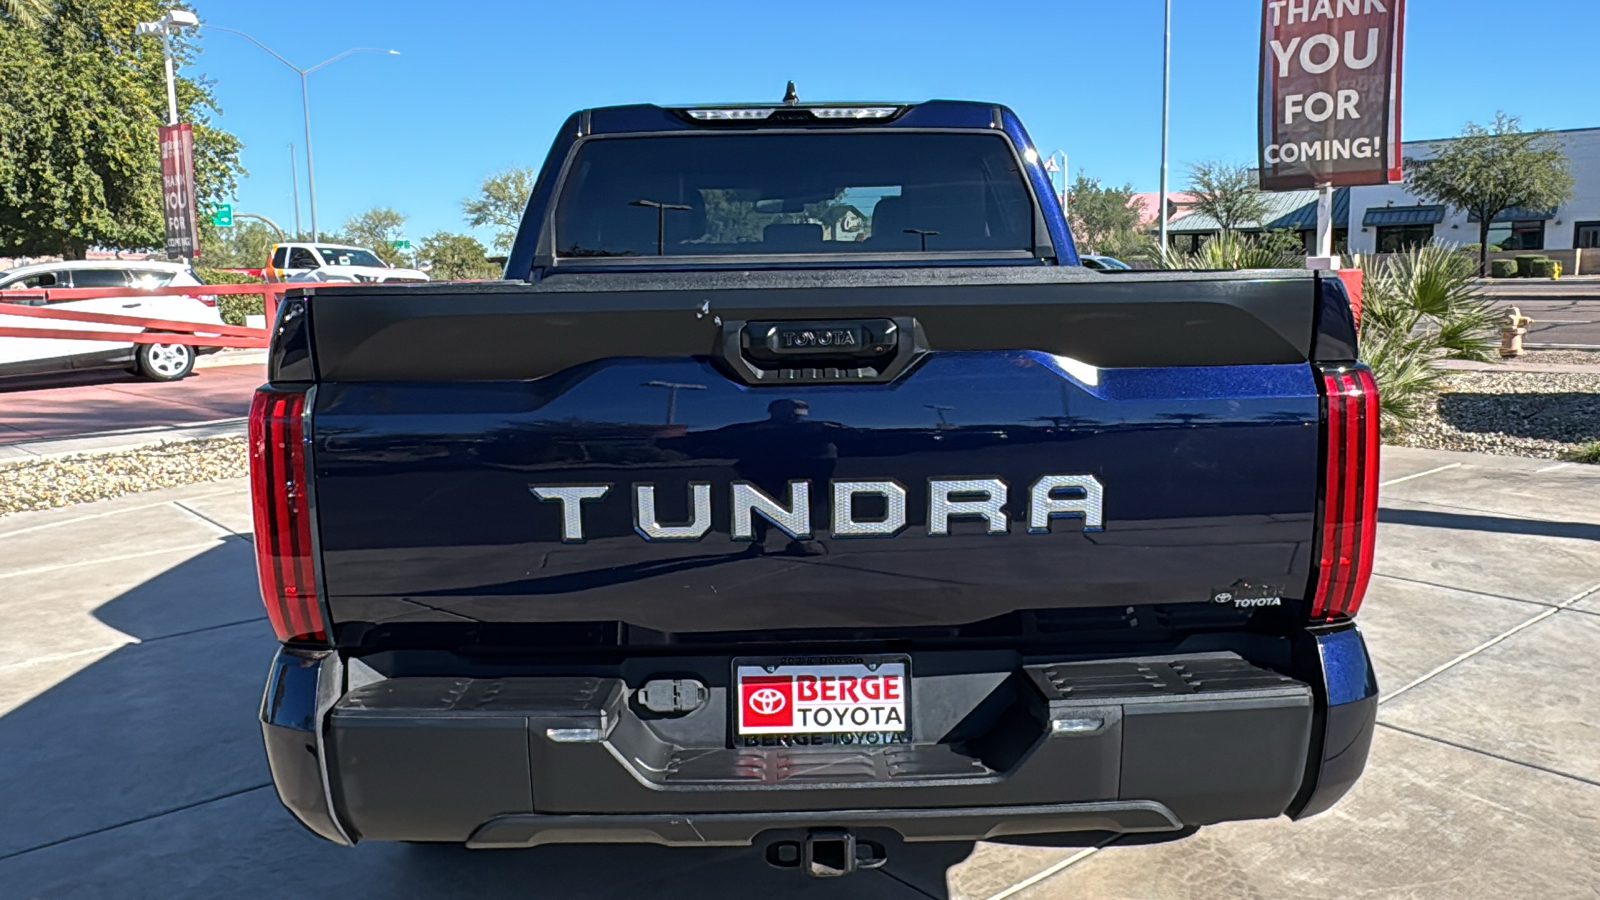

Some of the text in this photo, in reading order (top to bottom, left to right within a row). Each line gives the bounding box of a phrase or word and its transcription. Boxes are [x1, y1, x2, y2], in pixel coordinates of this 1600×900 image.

[1269, 0, 1387, 26] THANK
[1269, 28, 1379, 78] YOU
[1284, 89, 1361, 125] FOR
[1264, 136, 1380, 164] COMING!
[165, 191, 187, 210] YOU
[169, 216, 186, 230] FOR
[783, 330, 855, 346] TOYOTA
[528, 472, 1106, 543] TUNDRA
[1234, 597, 1281, 608] TOYOTA
[797, 674, 900, 703] BERGE
[797, 706, 902, 727] TOYOTA
[744, 731, 903, 748] BERGE TOYOTA
